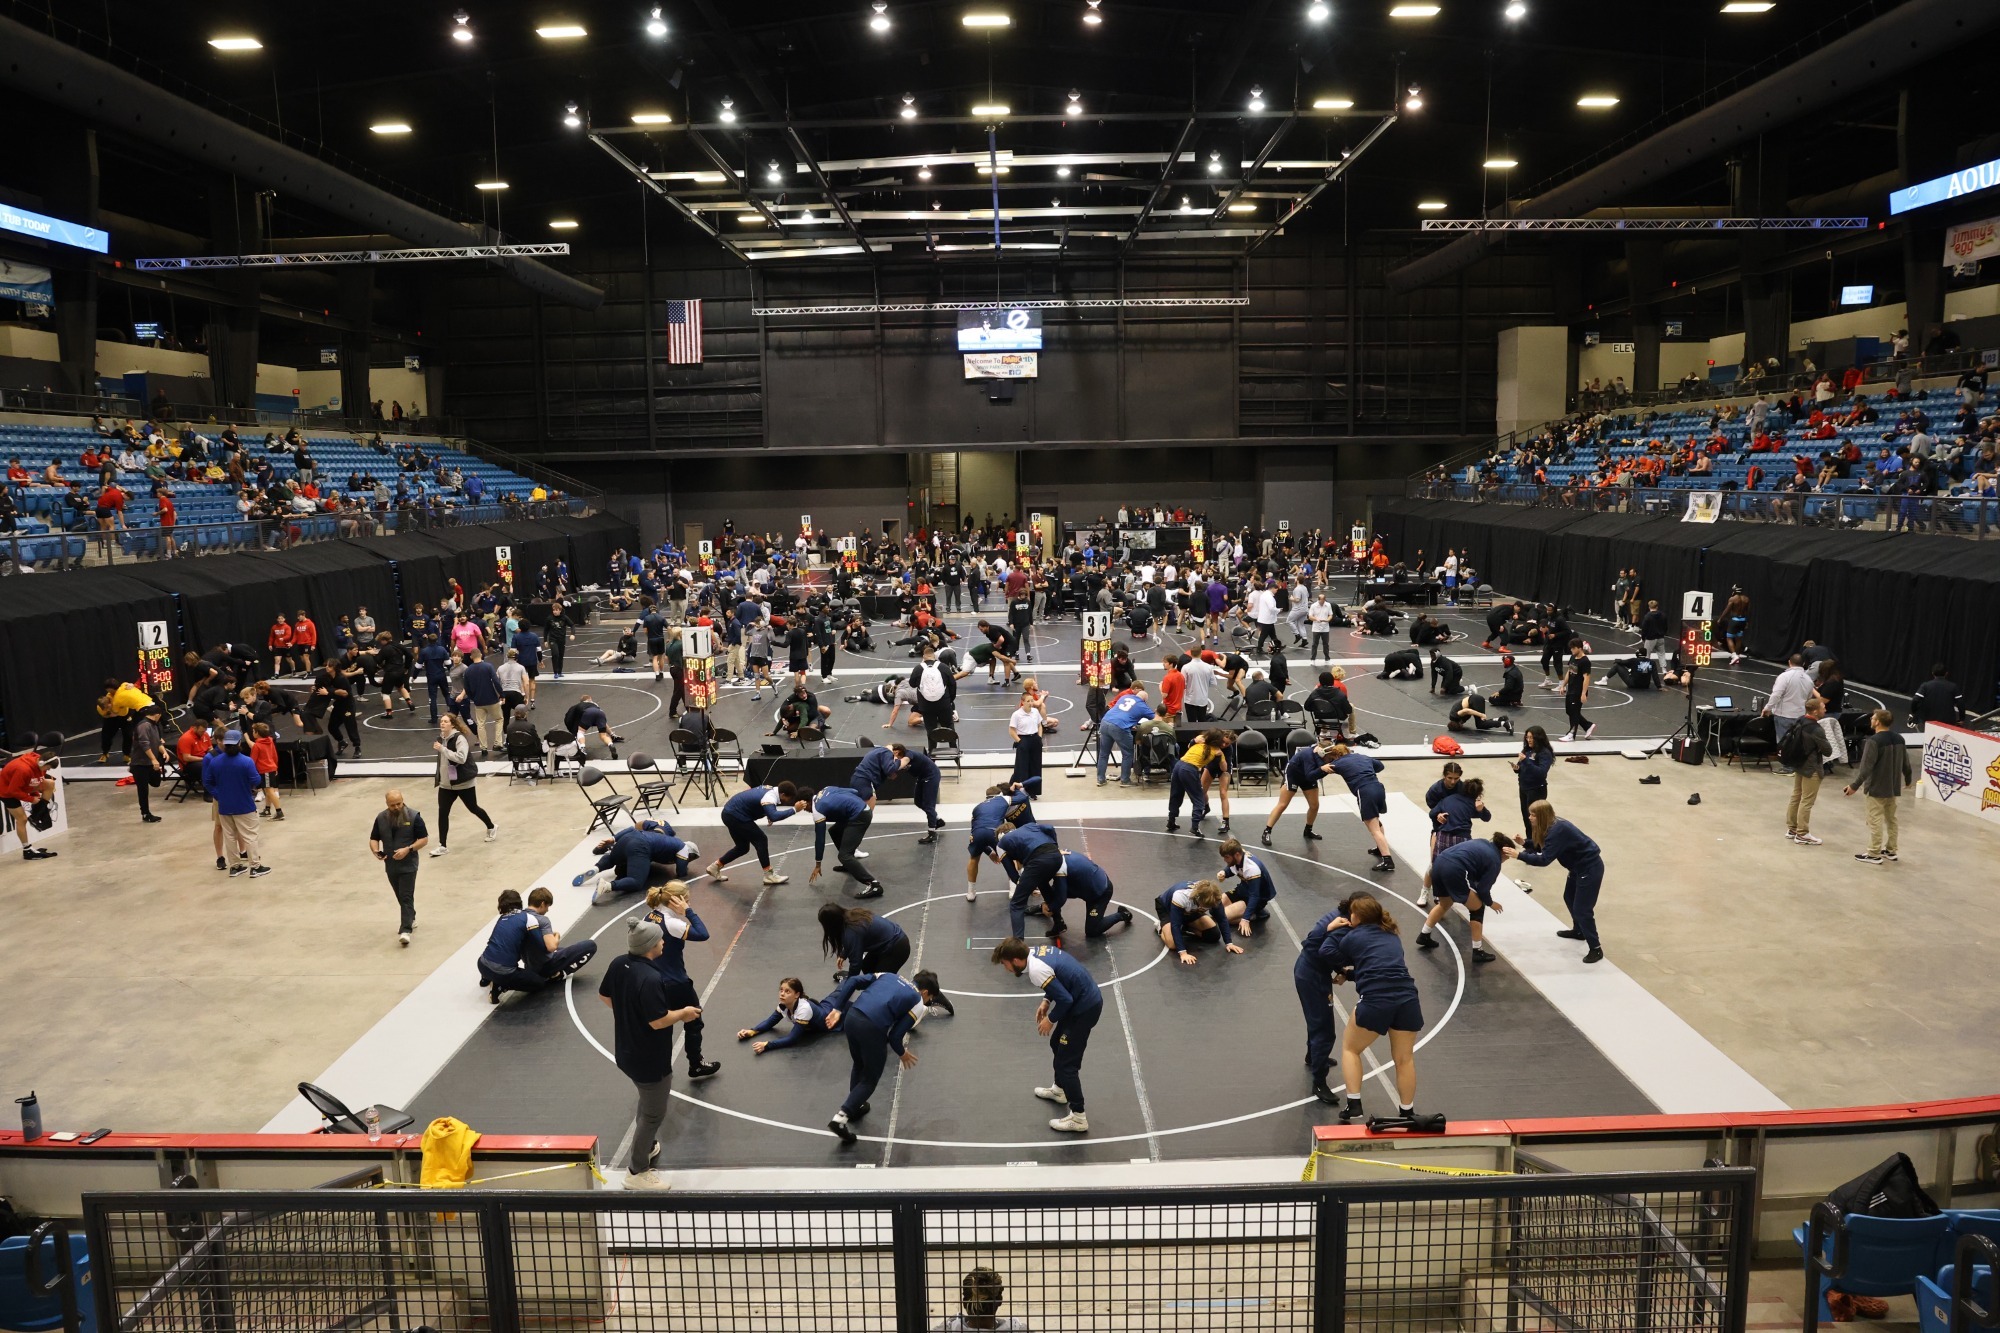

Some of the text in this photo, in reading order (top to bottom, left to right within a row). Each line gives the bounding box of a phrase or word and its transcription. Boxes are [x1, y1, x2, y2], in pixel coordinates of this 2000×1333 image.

[2, 212, 51, 233] TUB TODAY
[1955, 240, 1974, 256] egg
[22, 290, 52, 303] ENERGY
[1985, 353, 1997, 364] 103
[1194, 528, 1199, 538] 7
[1353, 530, 1361, 540] 10
[845, 539, 849, 549] 6
[1020, 534, 1026, 545] 9
[703, 543, 709, 552] 8
[501, 549, 507, 559] 5
[1691, 596, 1704, 617] 4
[1087, 615, 1094, 637] 3
[1102, 615, 1107, 637] 3
[1701, 620, 1712, 631] 12
[153, 625, 162, 645] 2
[1688, 630, 1711, 641] 0 0
[691, 632, 698, 654] 1
[1084, 640, 1097, 652] 1003
[149, 648, 169, 660] 1002
[1696, 654, 1710, 665] 00
[152, 657, 171, 670] 0 0
[153, 670, 172, 683] 3:00
[688, 669, 705, 682] 0 0
[1090, 675, 1098, 687] 00
[161, 680, 173, 692] 00
[696, 696, 706, 707] 00
[1118, 697, 1136, 712] 3
[1937, 739, 1961, 755] NBC
[1924, 743, 1972, 768] WORLD
[1923, 754, 1973, 781] SERIES
[1938, 1310, 1944, 1320] B
